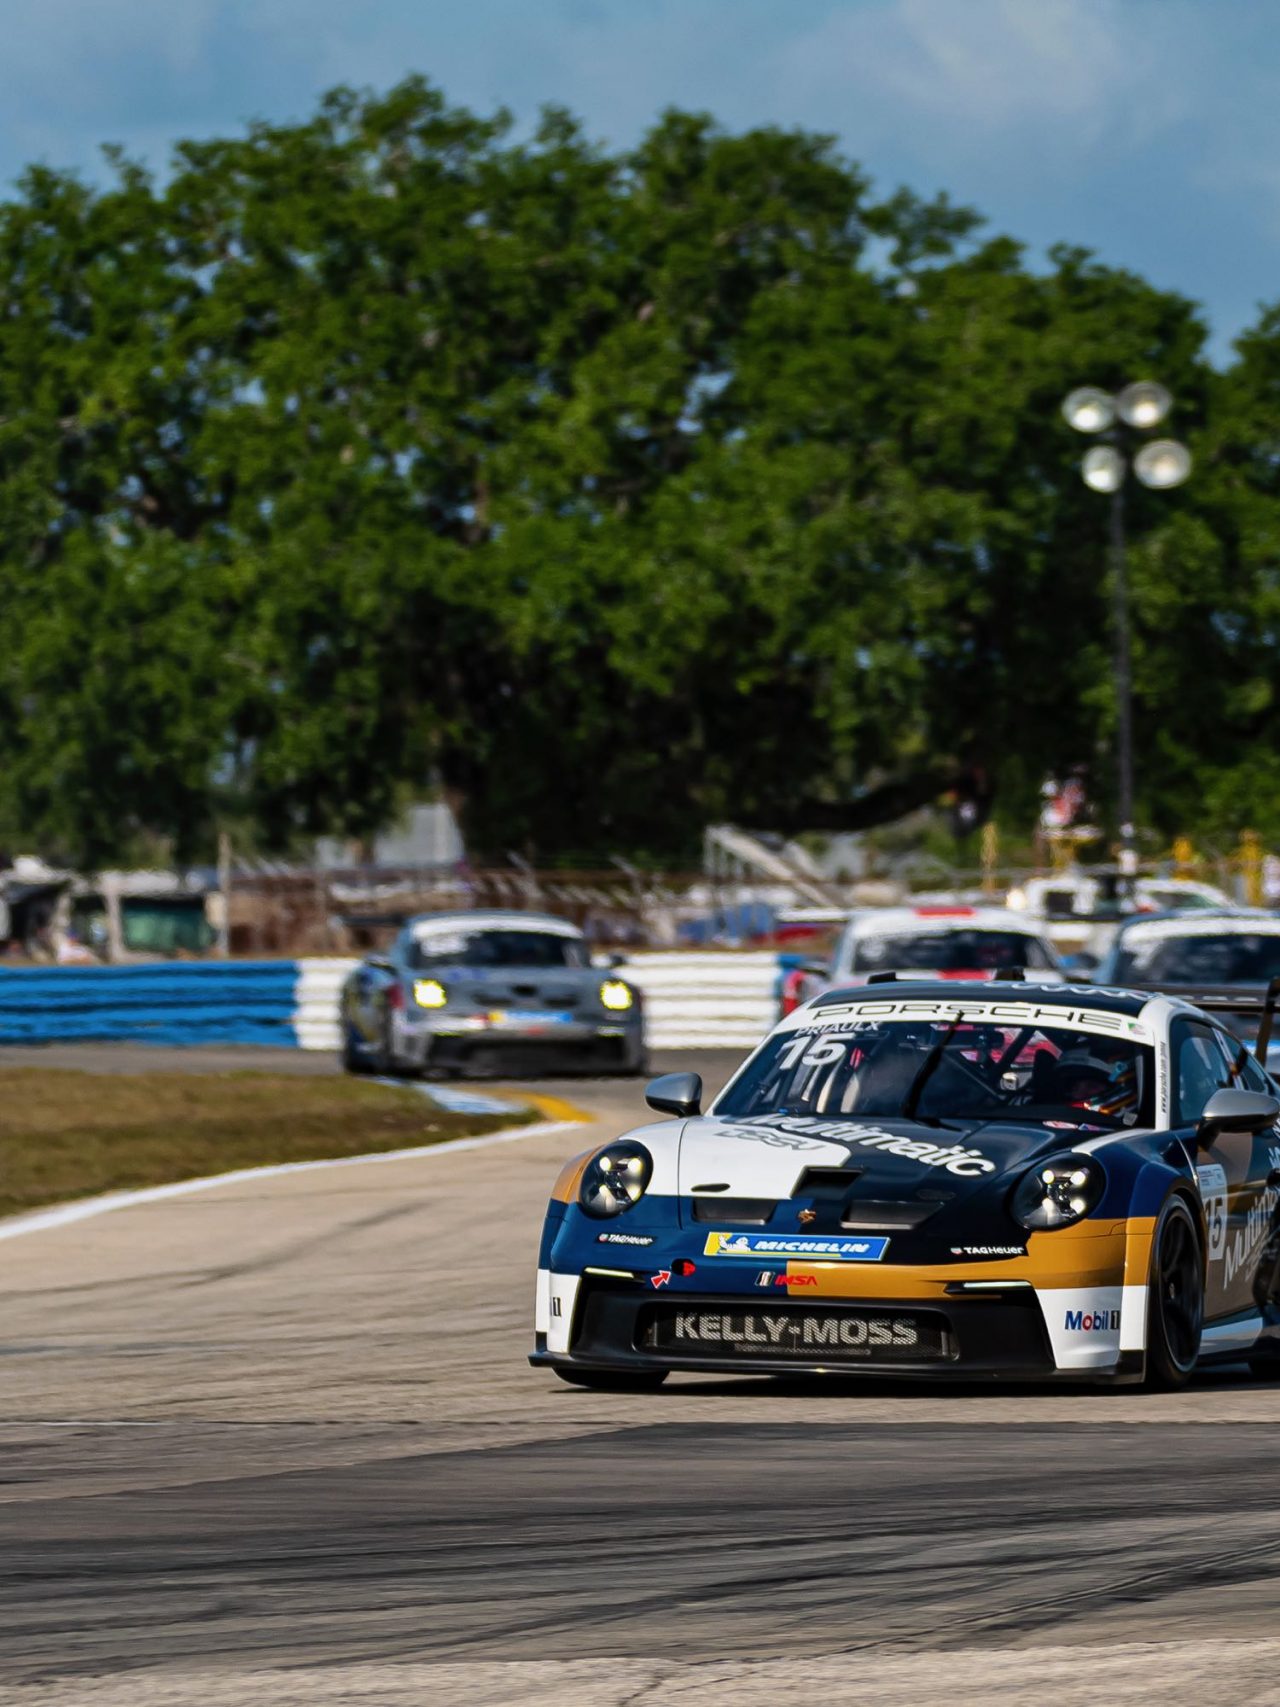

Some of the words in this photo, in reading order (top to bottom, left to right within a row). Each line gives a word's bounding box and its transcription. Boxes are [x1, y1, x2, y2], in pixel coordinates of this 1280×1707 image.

[813, 1003, 1122, 1030] PORSCHE
[794, 1021, 881, 1038] PRIAULX
[775, 1033, 856, 1070] 15
[736, 1112, 996, 1176] Multimatic
[754, 1240, 871, 1253] MICHELIN
[775, 1275, 818, 1287] IMSA
[1064, 1310, 1109, 1331] Mobil
[1110, 1311, 1121, 1330] 1
